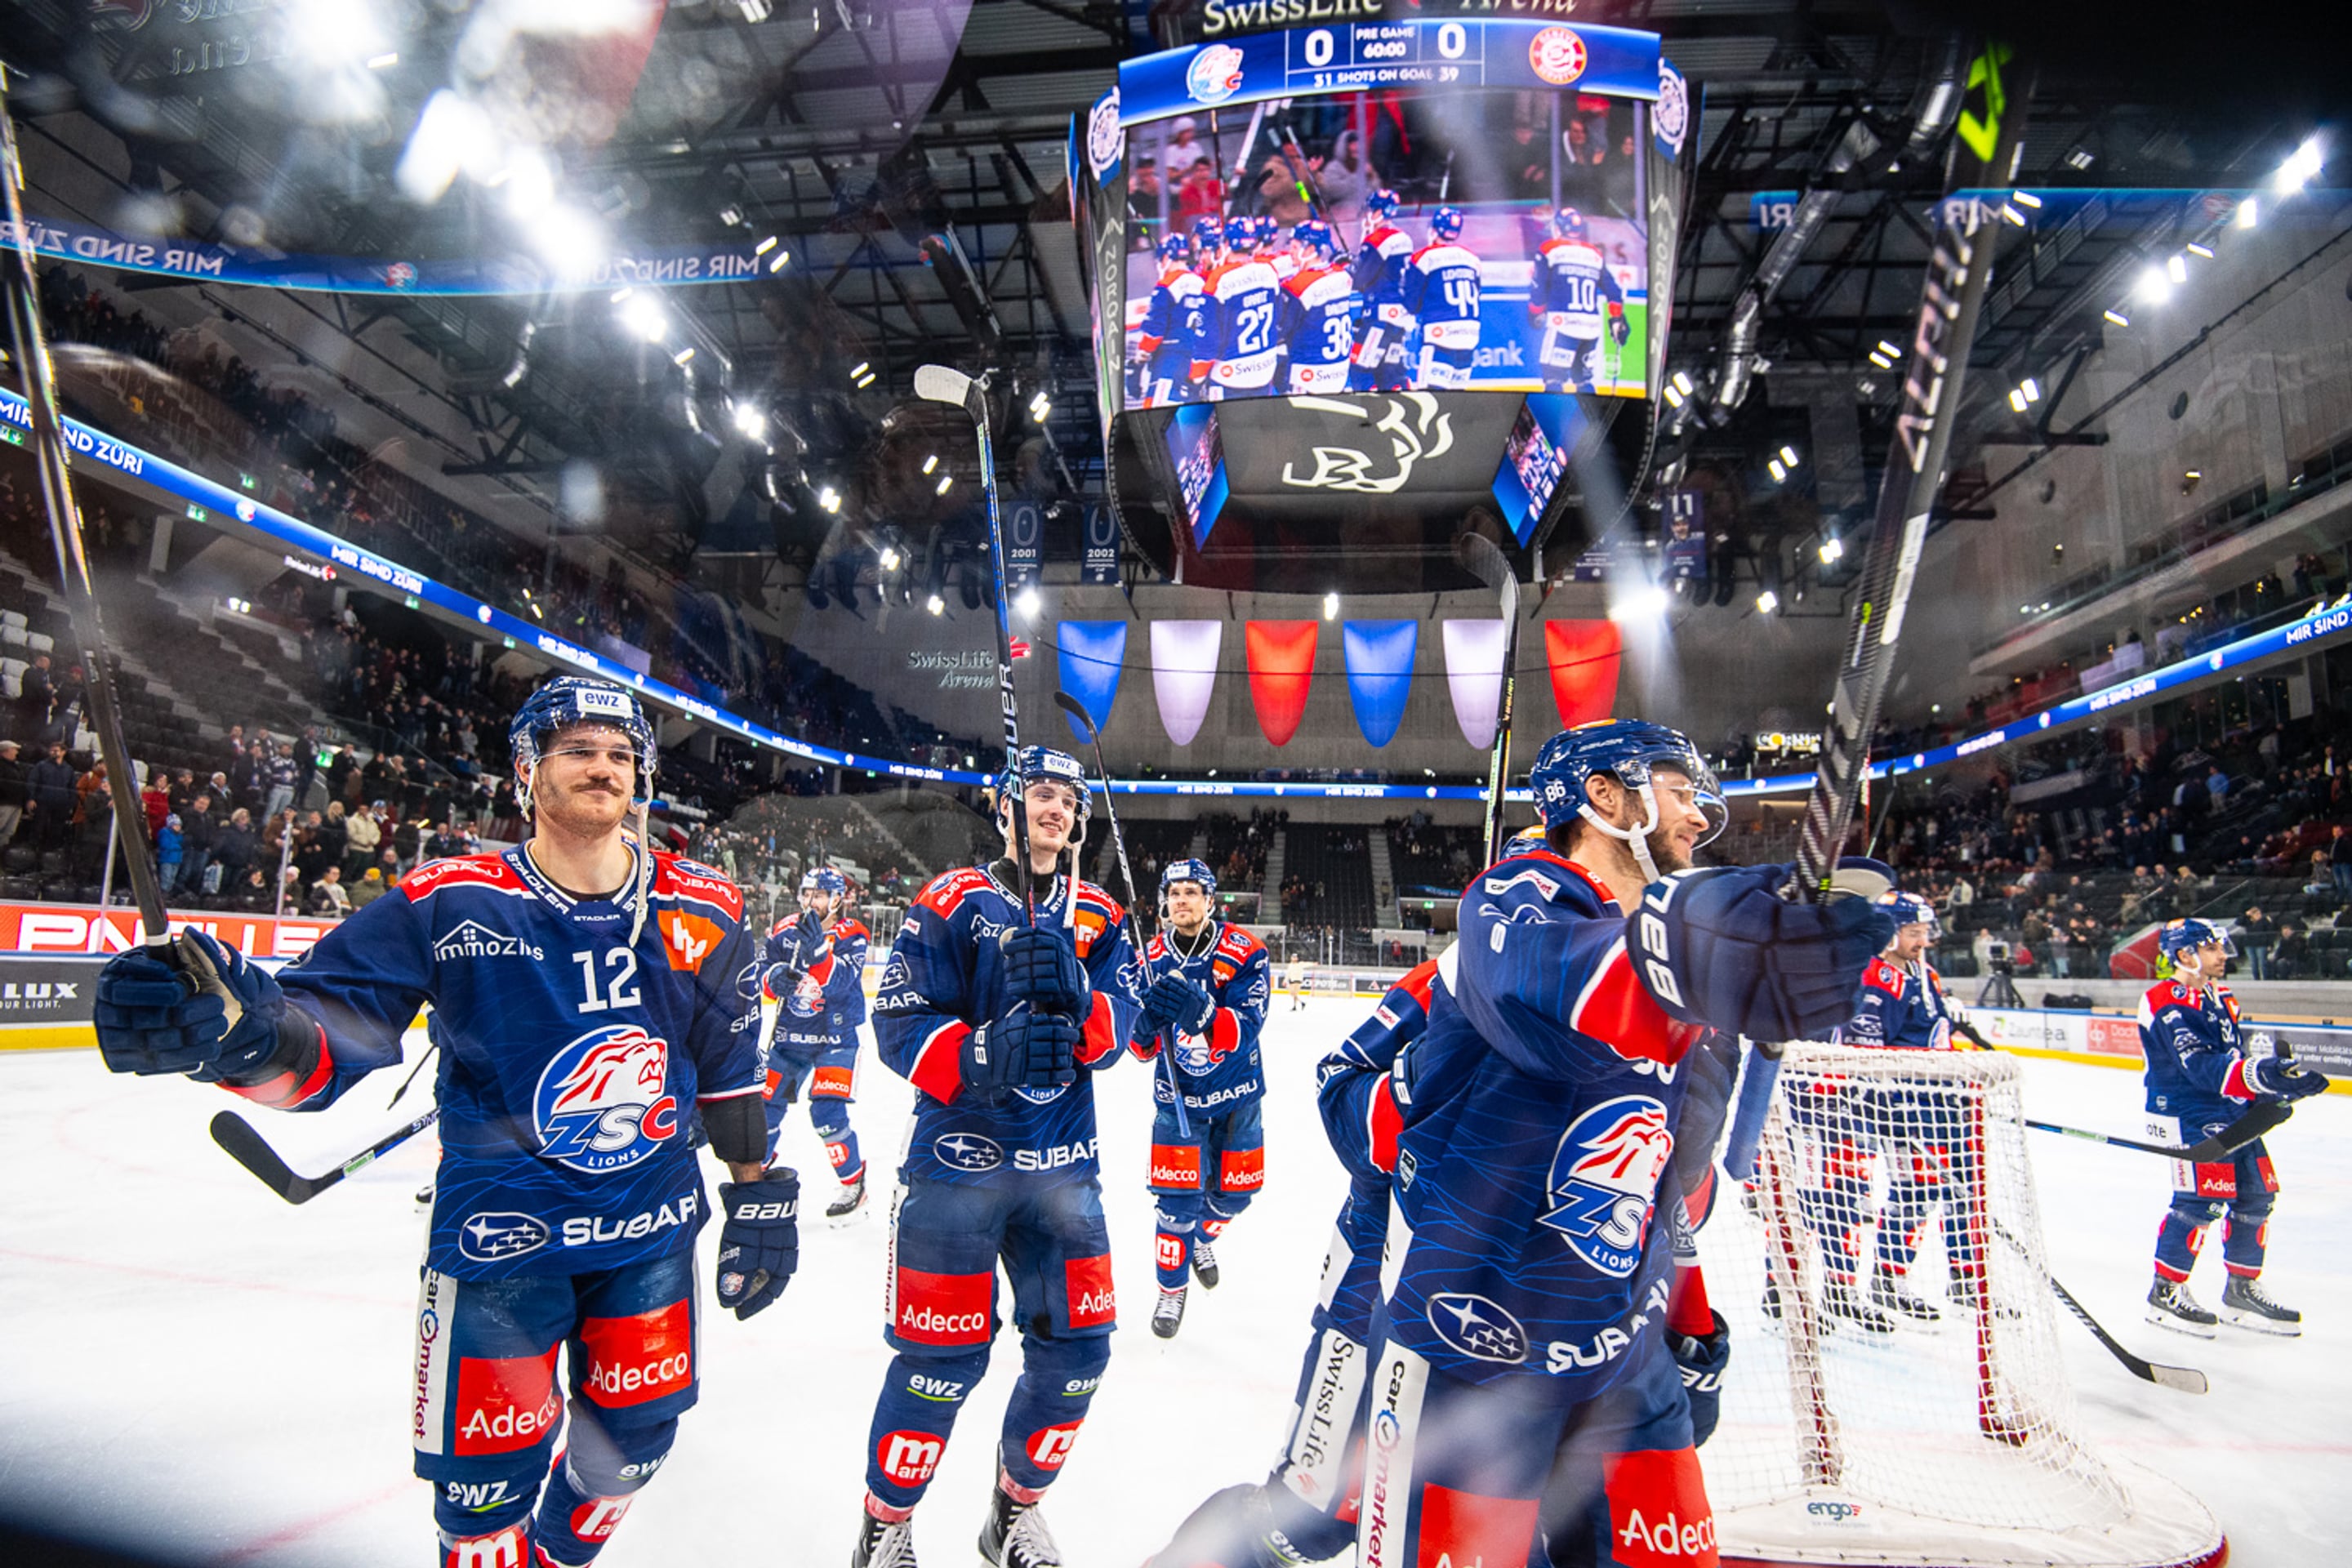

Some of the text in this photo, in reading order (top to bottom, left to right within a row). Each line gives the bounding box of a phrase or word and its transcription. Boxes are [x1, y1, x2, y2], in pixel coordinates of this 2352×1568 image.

[1356, 26, 1415, 40] PRE GAME
[1438, 23, 1466, 59] 0
[1305, 29, 1334, 66] 0
[1363, 42, 1406, 58] 60:00
[1314, 67, 1459, 87] 31 SHOTS ON GOAL 39
[1444, 280, 1481, 318] 44
[1567, 277, 1595, 313] 10
[1649, 222, 1669, 359] NORQAIN
[1105, 247, 1122, 375] NORQAIN
[1236, 302, 1275, 354] 27
[63, 425, 94, 452] ND
[96, 441, 144, 475] ZÜRI
[1668, 494, 1693, 516] 11
[1011, 549, 1036, 558] 2001
[1087, 549, 1115, 558] 2002
[331, 543, 359, 568] MIR
[359, 556, 392, 582] SIND
[392, 570, 424, 595] ZÜRI
[2287, 613, 2349, 645] MIR SIND
[907, 650, 995, 669] SwissLife
[939, 670, 995, 688] Arena
[584, 693, 619, 708] ewz
[998, 663, 1024, 803] BAUER
[1049, 757, 1072, 770] ewz
[1545, 781, 1566, 802] 86
[506, 853, 571, 915] STADLER
[573, 914, 621, 922] STADLER
[572, 946, 642, 1014] 12
[24, 1000, 62, 1010] LIGHT.
[1174, 1046, 1226, 1066] ZSC
[815, 1078, 850, 1094] Adecco
[1184, 1079, 1258, 1109] SUBARU
[536, 1095, 678, 1159] ZSC
[586, 1147, 640, 1169] LIONS
[1152, 1164, 1198, 1183] Adecco
[1590, 1244, 1635, 1271] LIONS
[901, 1304, 987, 1333] Adecco
[590, 1352, 689, 1394] Adecco
[909, 1373, 964, 1398] ewz
[1300, 1336, 1355, 1468] SwissLife
[1365, 1360, 1405, 1568] car market
[447, 1480, 509, 1508] ewz
[1806, 1502, 1853, 1521] engo
